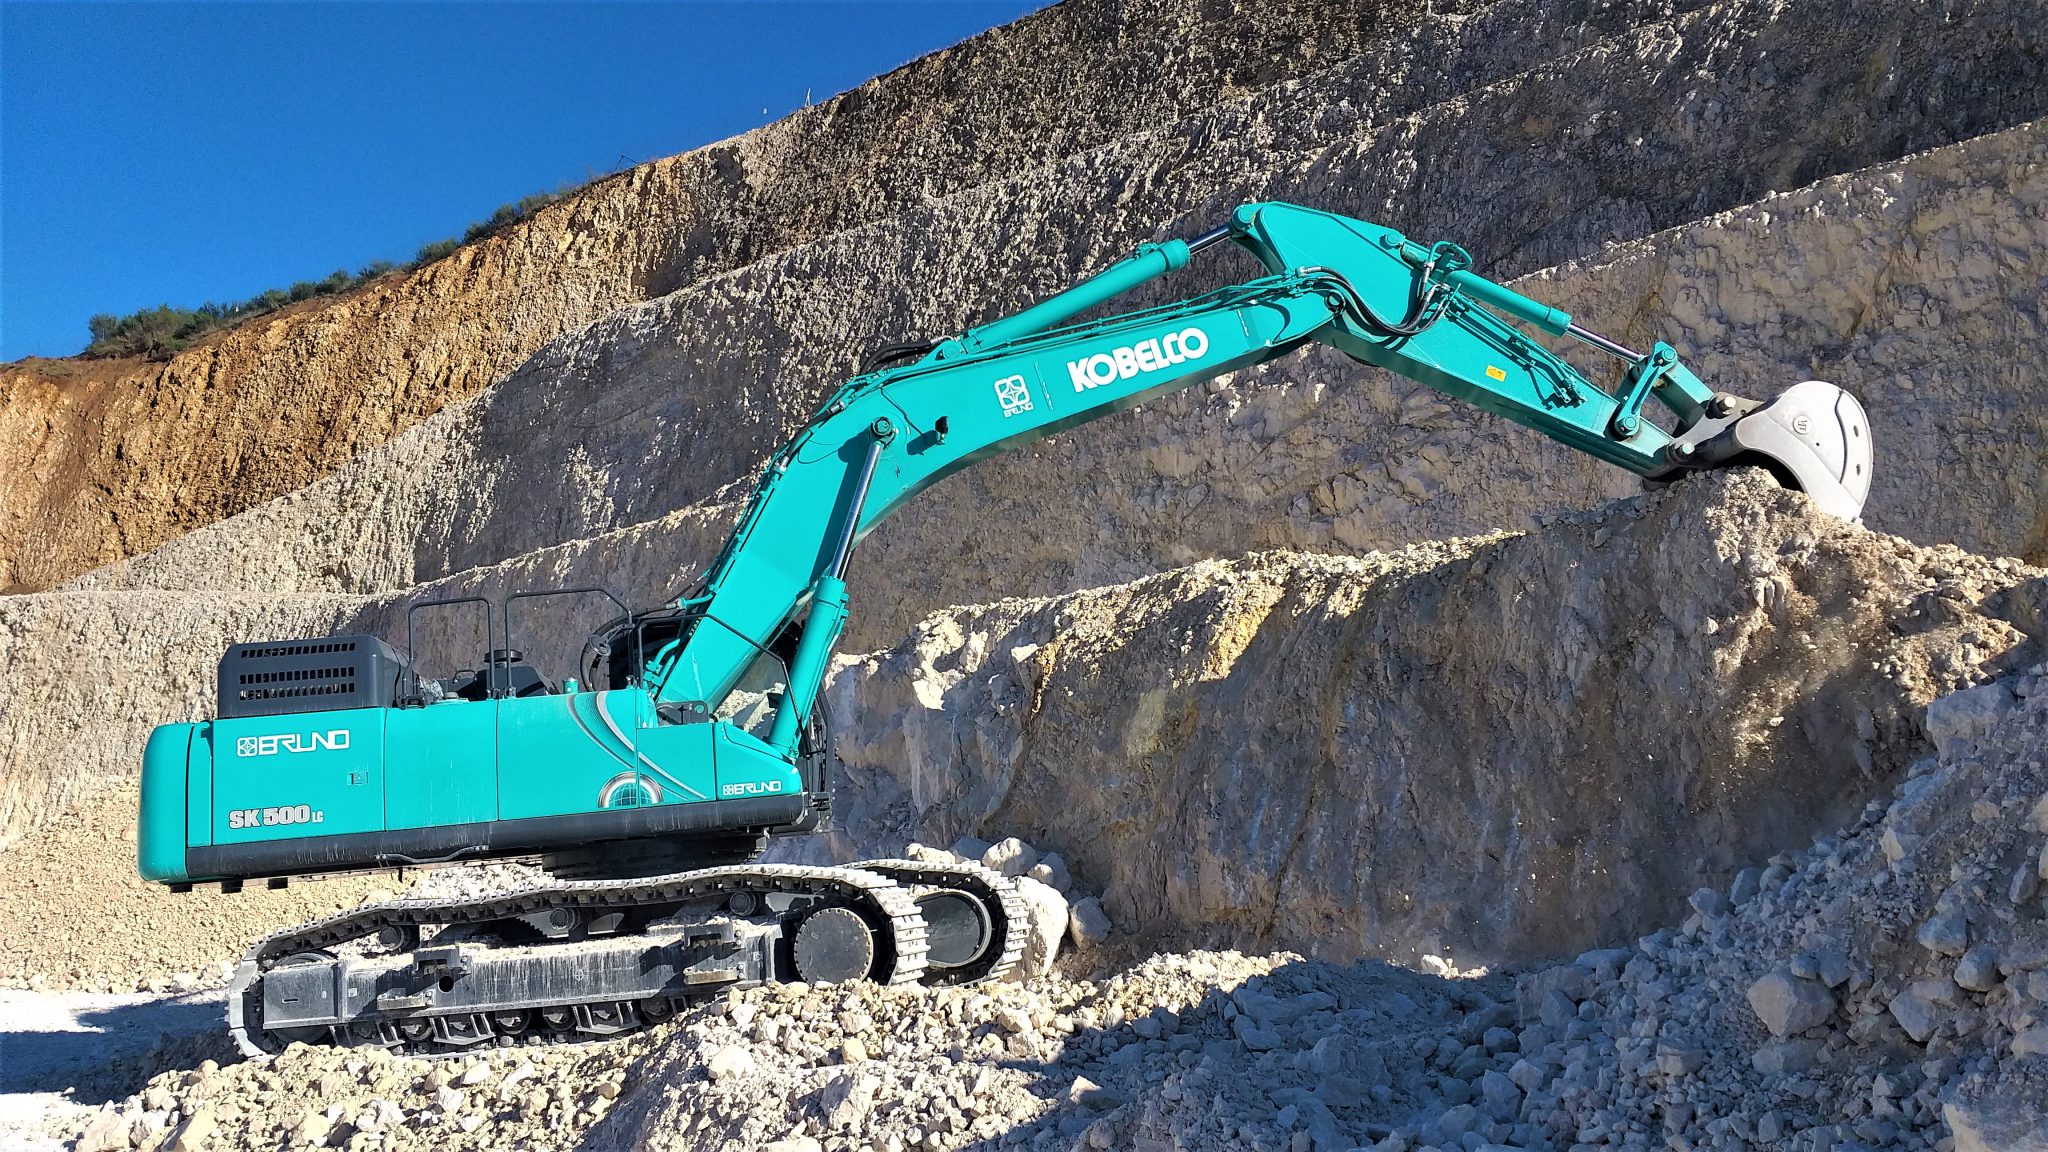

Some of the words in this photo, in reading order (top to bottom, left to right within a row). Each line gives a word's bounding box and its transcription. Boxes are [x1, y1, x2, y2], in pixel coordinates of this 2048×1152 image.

[1067, 327, 1209, 393] KOBELCO
[229, 808, 261, 828] SK
[262, 804, 311, 825] 500
[311, 810, 324, 823] LC
